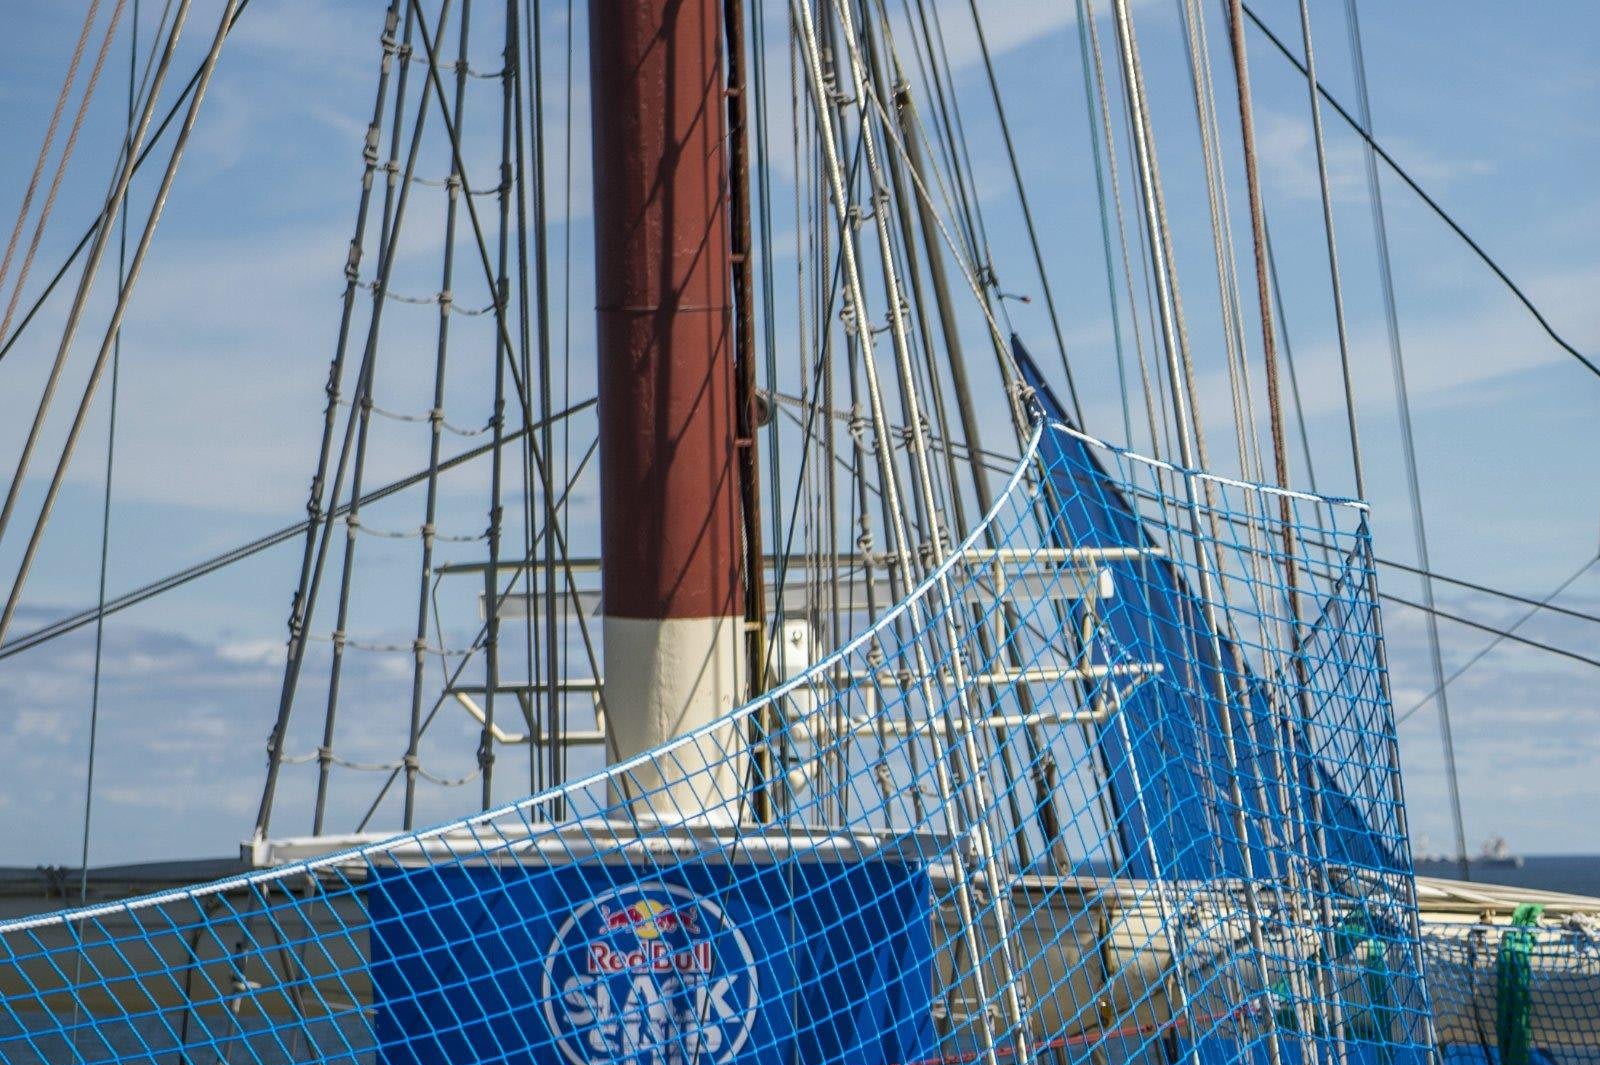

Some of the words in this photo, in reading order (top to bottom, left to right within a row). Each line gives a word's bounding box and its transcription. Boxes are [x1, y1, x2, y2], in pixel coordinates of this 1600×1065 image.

[587, 941, 649, 974] Red
[650, 938, 712, 974] Bull
[563, 974, 741, 1026] SLACK
